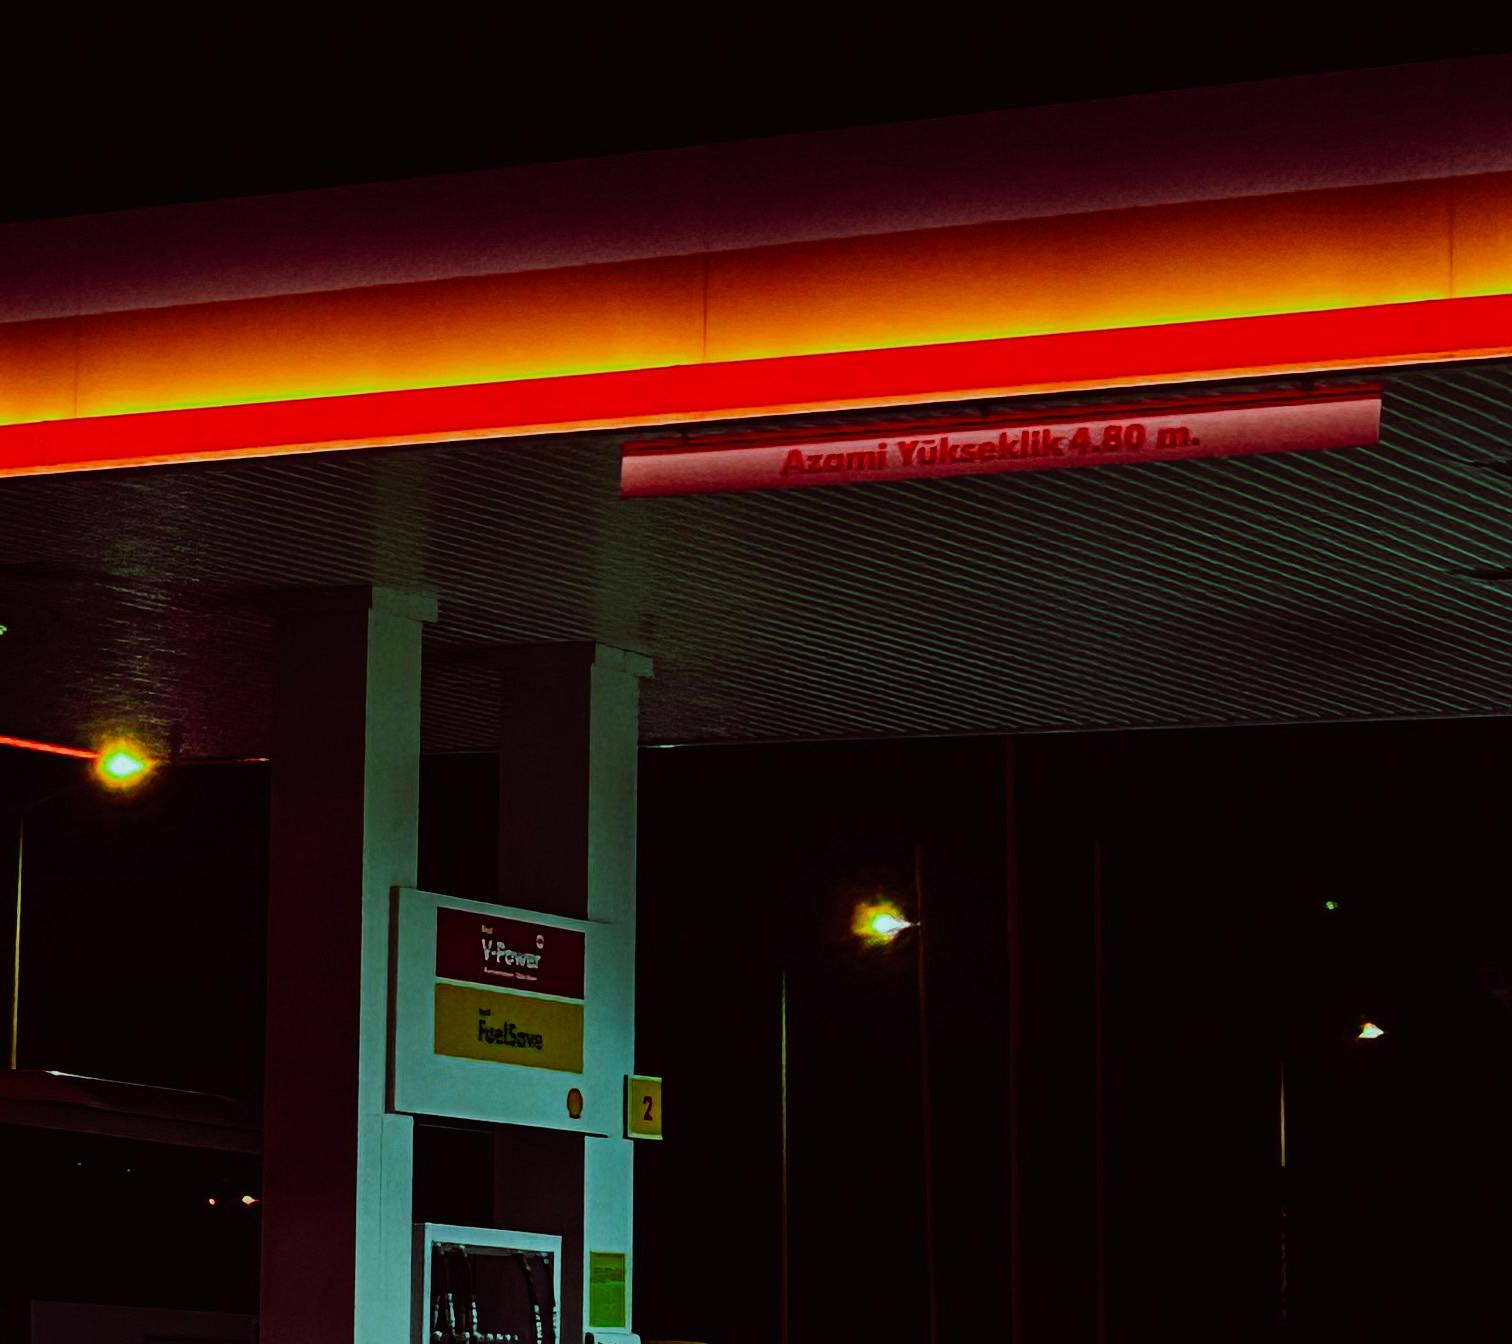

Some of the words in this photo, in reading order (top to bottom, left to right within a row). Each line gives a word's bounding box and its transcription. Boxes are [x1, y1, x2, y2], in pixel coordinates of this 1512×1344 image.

[780, 443, 887, 477] Azami
[897, 429, 1067, 466] Yükseklik
[1069, 424, 1145, 454] 4.80
[1157, 426, 1201, 448] m.
[481, 938, 541, 968] V-Power
[478, 1020, 543, 1050] FuelSave
[642, 1096, 654, 1121] 2
